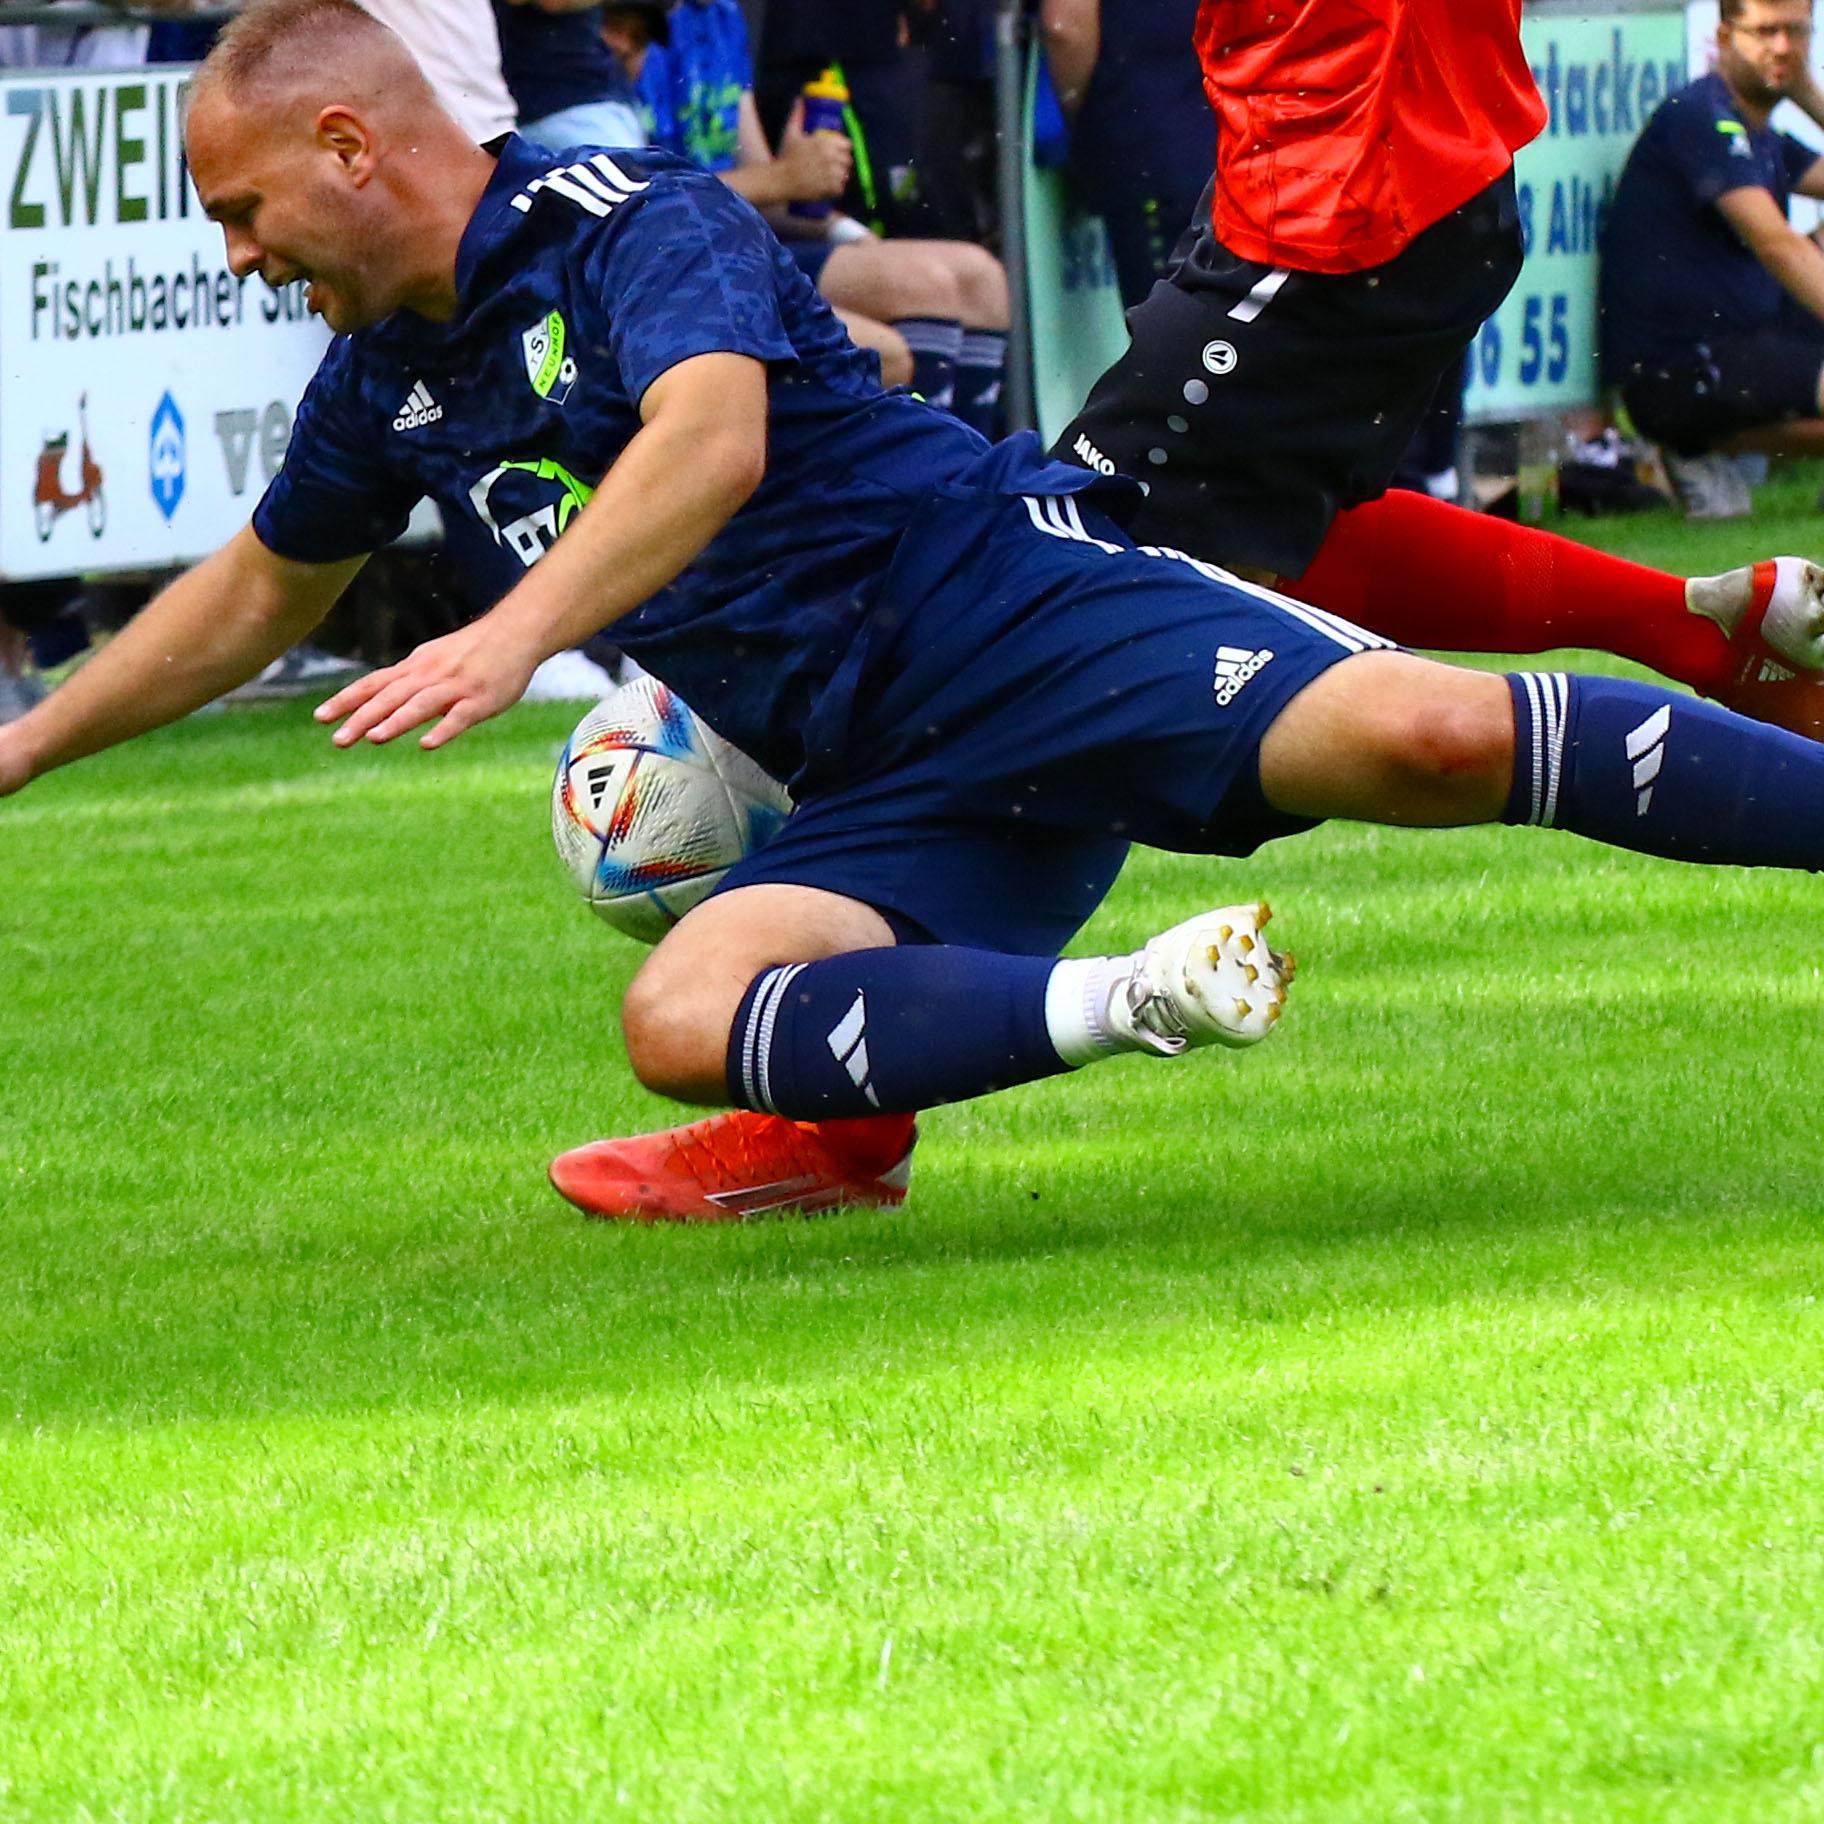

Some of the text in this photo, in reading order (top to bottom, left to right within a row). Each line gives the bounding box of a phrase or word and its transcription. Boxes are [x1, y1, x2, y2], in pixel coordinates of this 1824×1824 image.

[6, 83, 189, 229] ZWEI
[29, 251, 245, 340] Fischbacher
[1519, 293, 1569, 386] 55
[391, 404, 444, 432] adidas
[1072, 432, 1116, 477] JAKO
[1215, 648, 1275, 707] adidas
